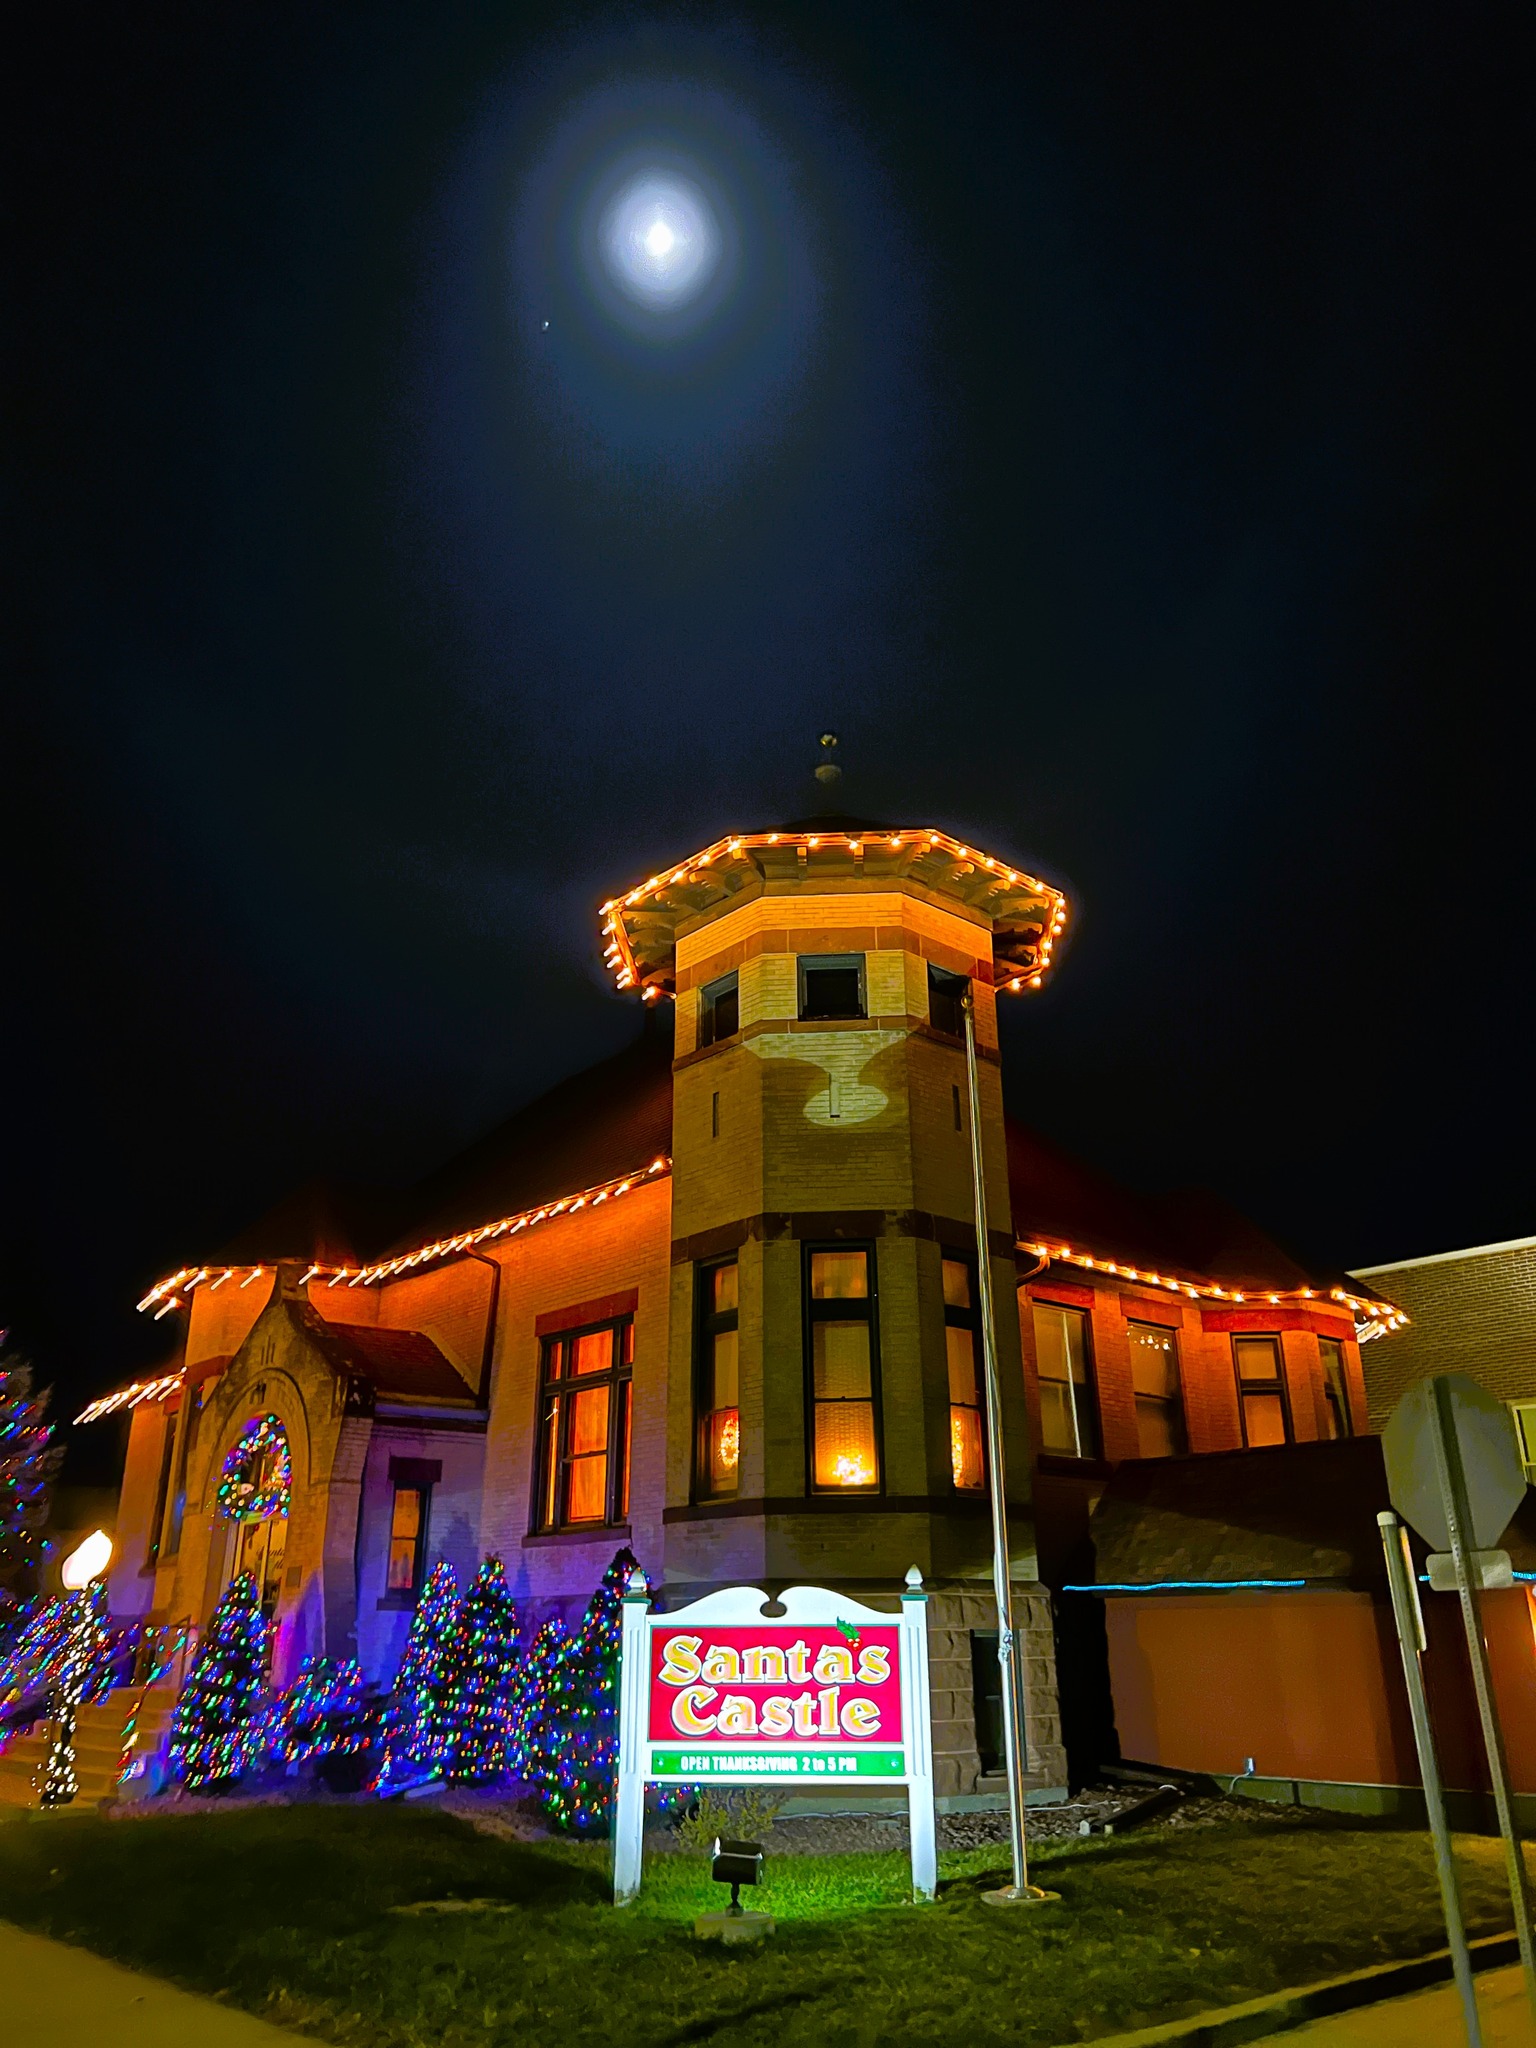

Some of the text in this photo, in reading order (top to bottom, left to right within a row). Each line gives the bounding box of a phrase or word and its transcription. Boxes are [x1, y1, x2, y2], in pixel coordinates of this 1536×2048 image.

[671, 1685, 882, 1737] Castle
[680, 1756, 858, 1772] OPEN THANKSGIVING 2 to 5 PM
